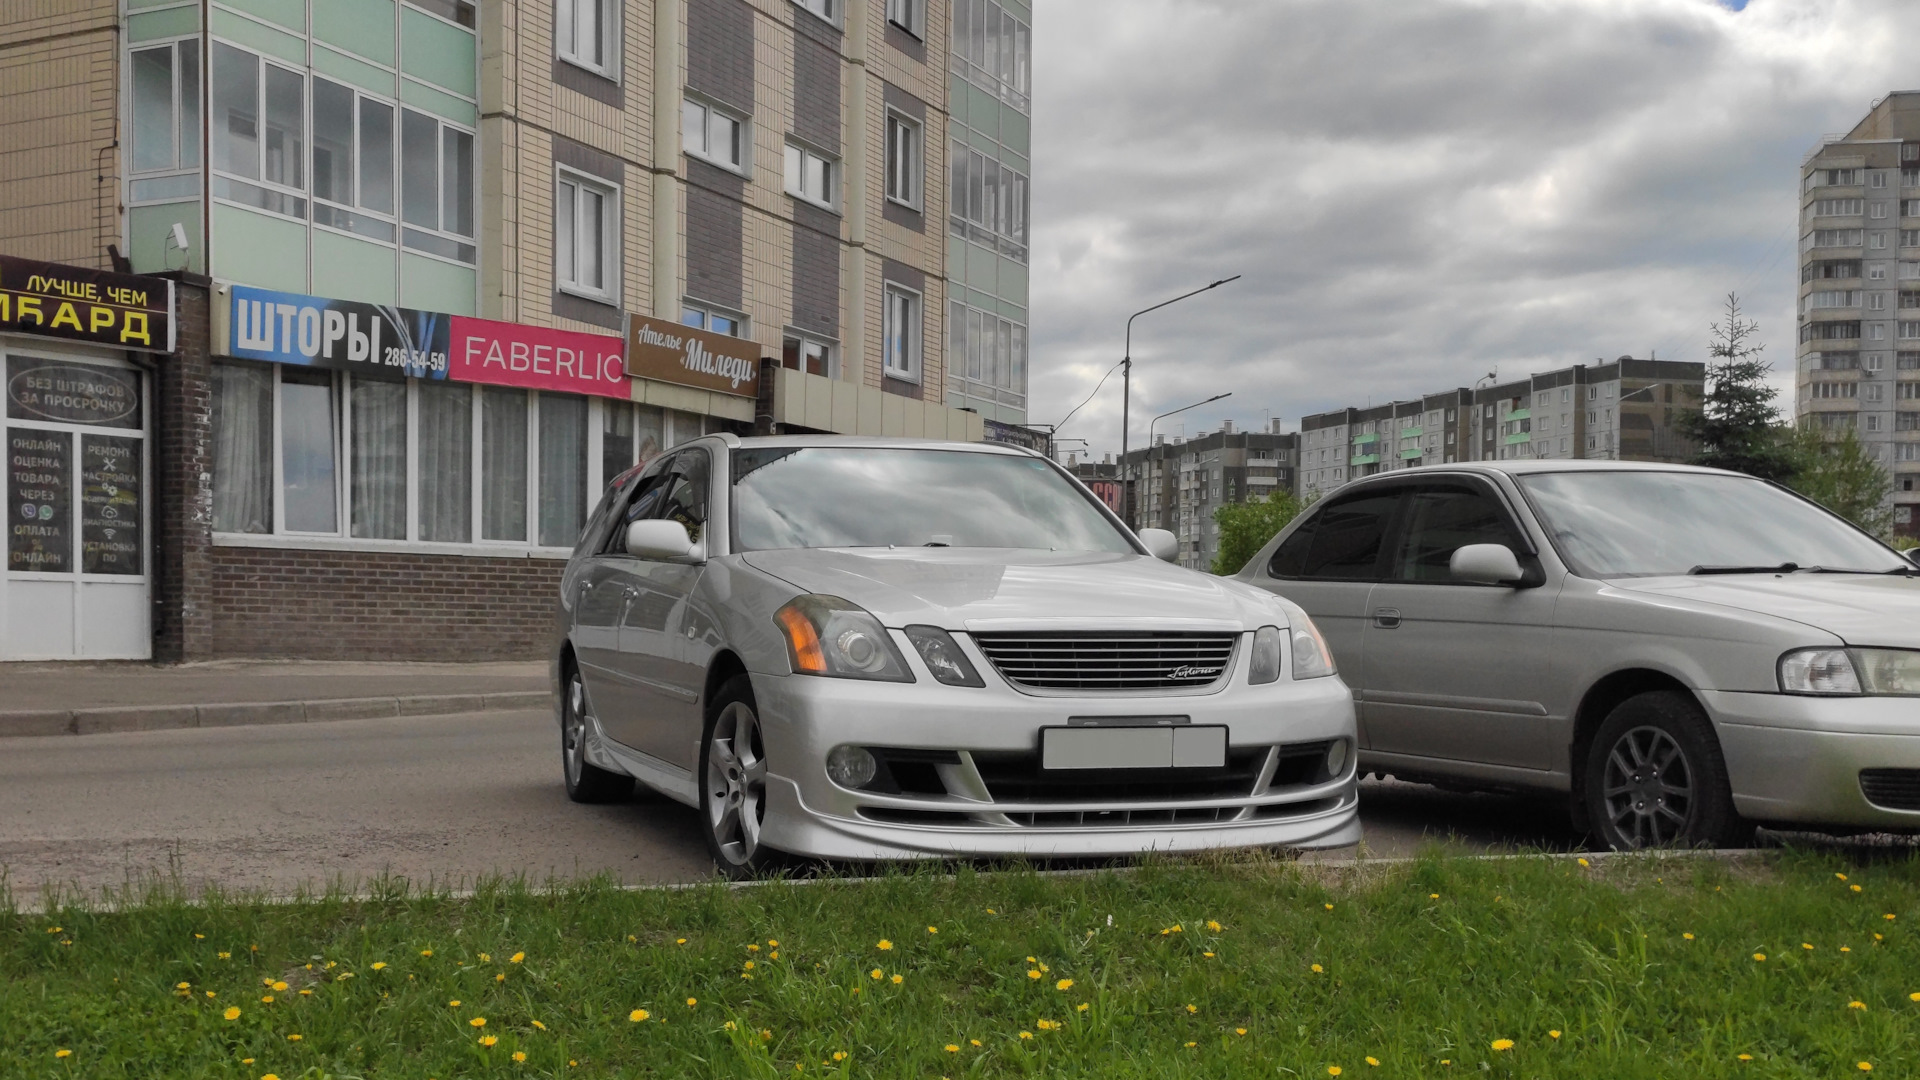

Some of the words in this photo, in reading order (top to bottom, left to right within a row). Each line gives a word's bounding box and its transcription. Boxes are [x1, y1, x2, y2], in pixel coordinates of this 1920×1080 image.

[27, 274, 102, 303] ЛУЧШЕ,
[107, 286, 147, 307] ЧЕМ
[237, 298, 381, 364] ШТОРЫ
[384, 346, 446, 371] 286-54-59
[638, 323, 682, 351] Ателье
[465, 335, 623, 384] FABERLIC
[679, 337, 757, 389] «Миледи»
[26, 376, 52, 390] БЕЗ
[57, 379, 125, 398] ШТРАФОВ
[21, 391, 40, 404] ЗА
[44, 394, 126, 413] ПРОСРОЧКУ
[13, 438, 61, 452] ОНЛАЙН
[13, 455, 61, 469] ОЦЕНКА
[14, 471, 60, 486] ТОВАРА
[82, 471, 137, 483] НАСТРОЙКА
[20, 488, 55, 501] ЧЕРЕЗ
[14, 524, 60, 537] ОПЛАТА
[13, 551, 61, 563] ОНЛАЙН
